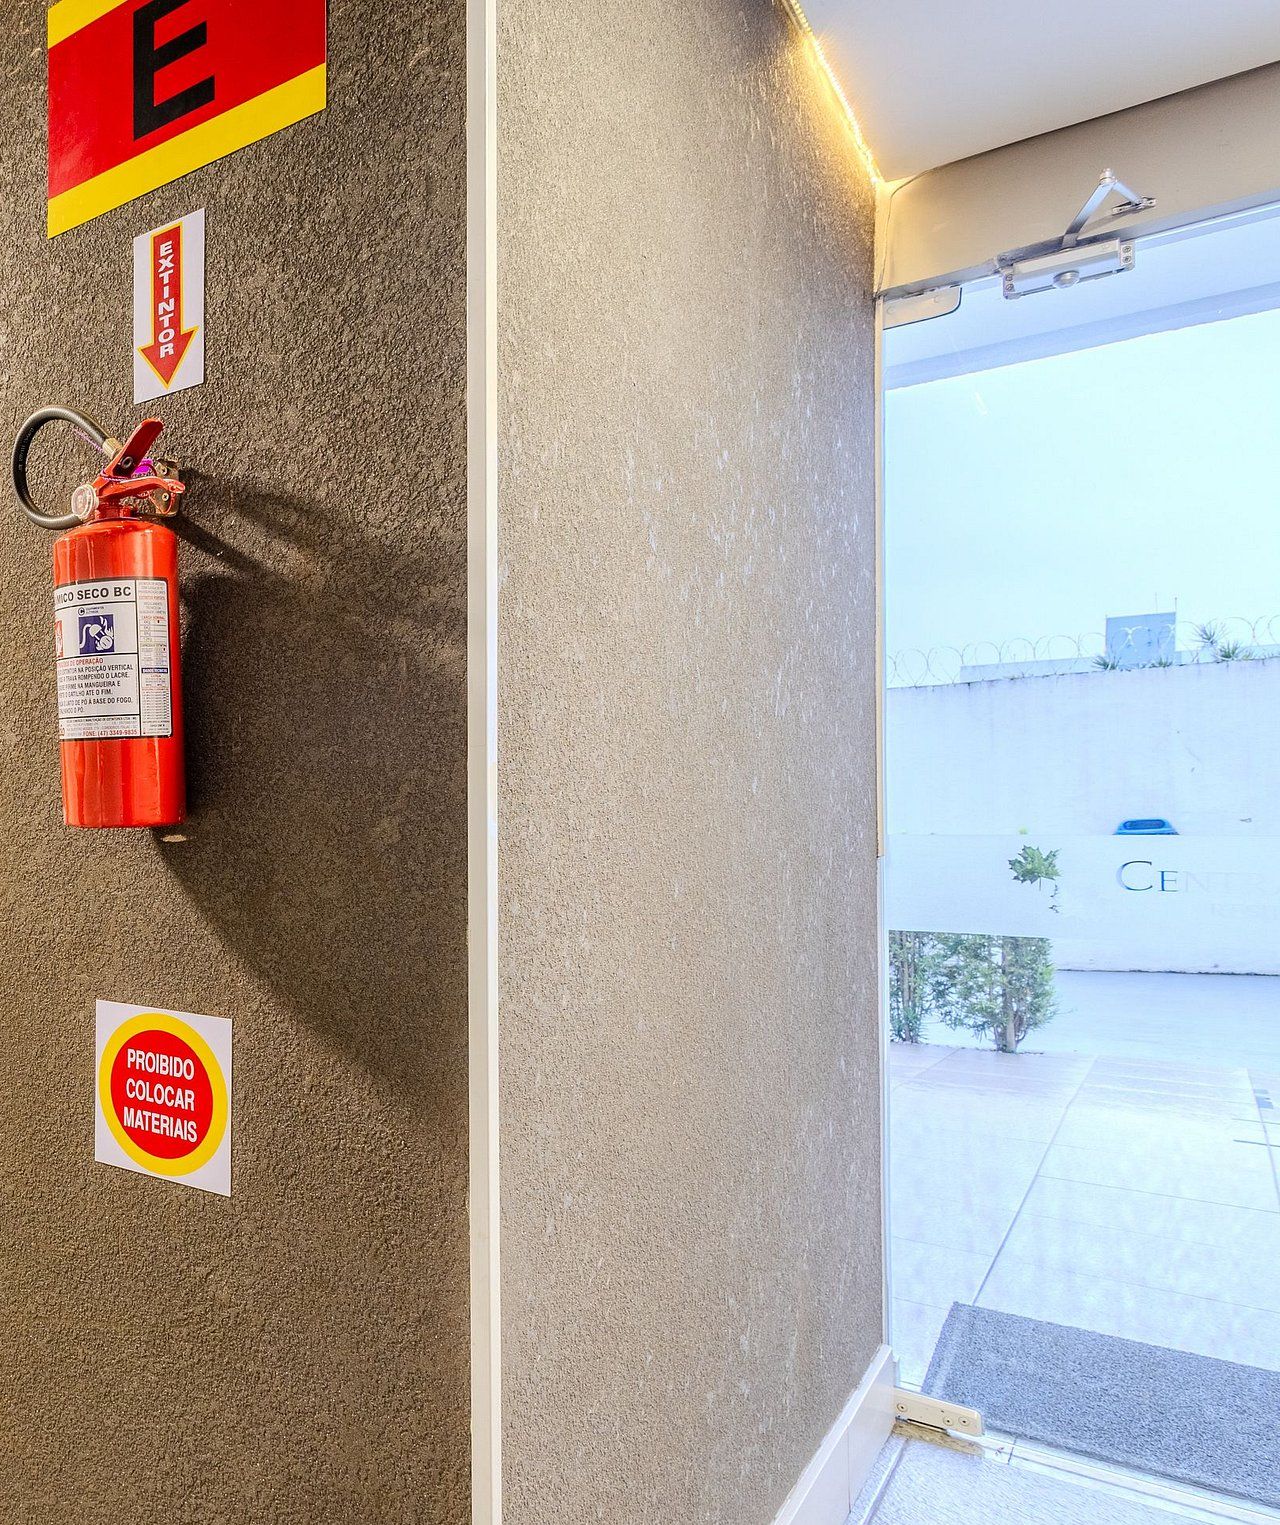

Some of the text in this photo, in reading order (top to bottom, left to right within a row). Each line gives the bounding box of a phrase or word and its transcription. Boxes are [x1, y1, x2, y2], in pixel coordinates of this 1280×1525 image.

[133, 0, 215, 141] E
[157, 240, 175, 359] EXTINTOR
[77, 588, 109, 600] SECO
[114, 586, 132, 597] BC
[127, 1048, 195, 1081] PROIBIDO
[125, 1078, 195, 1112] COLOCAR
[123, 1106, 198, 1143] MATERIAIS
